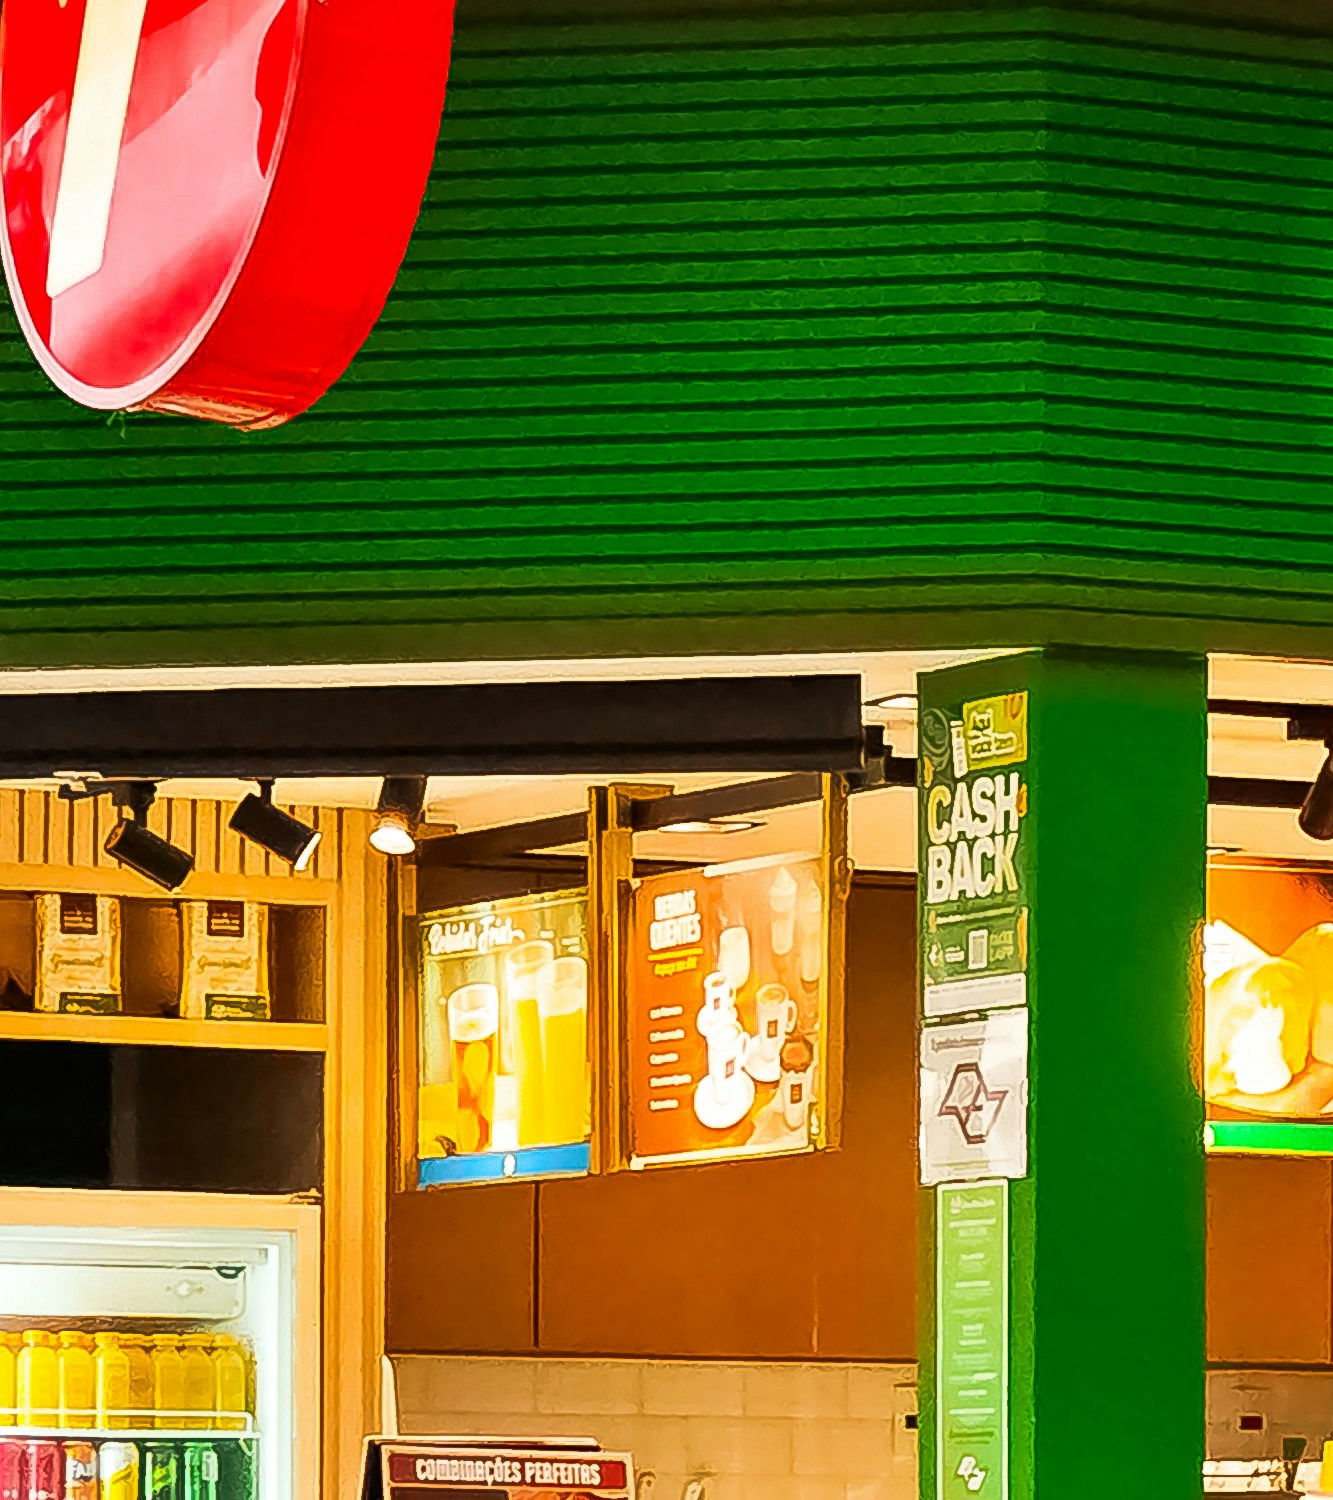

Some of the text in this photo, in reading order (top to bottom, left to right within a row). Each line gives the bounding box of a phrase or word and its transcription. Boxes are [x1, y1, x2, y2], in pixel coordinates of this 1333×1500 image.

[927, 772, 1019, 844] CASH
[926, 833, 1019, 904] BACK
[415, 1456, 601, 1487] COMBINAÇÕES PERFEITAS
